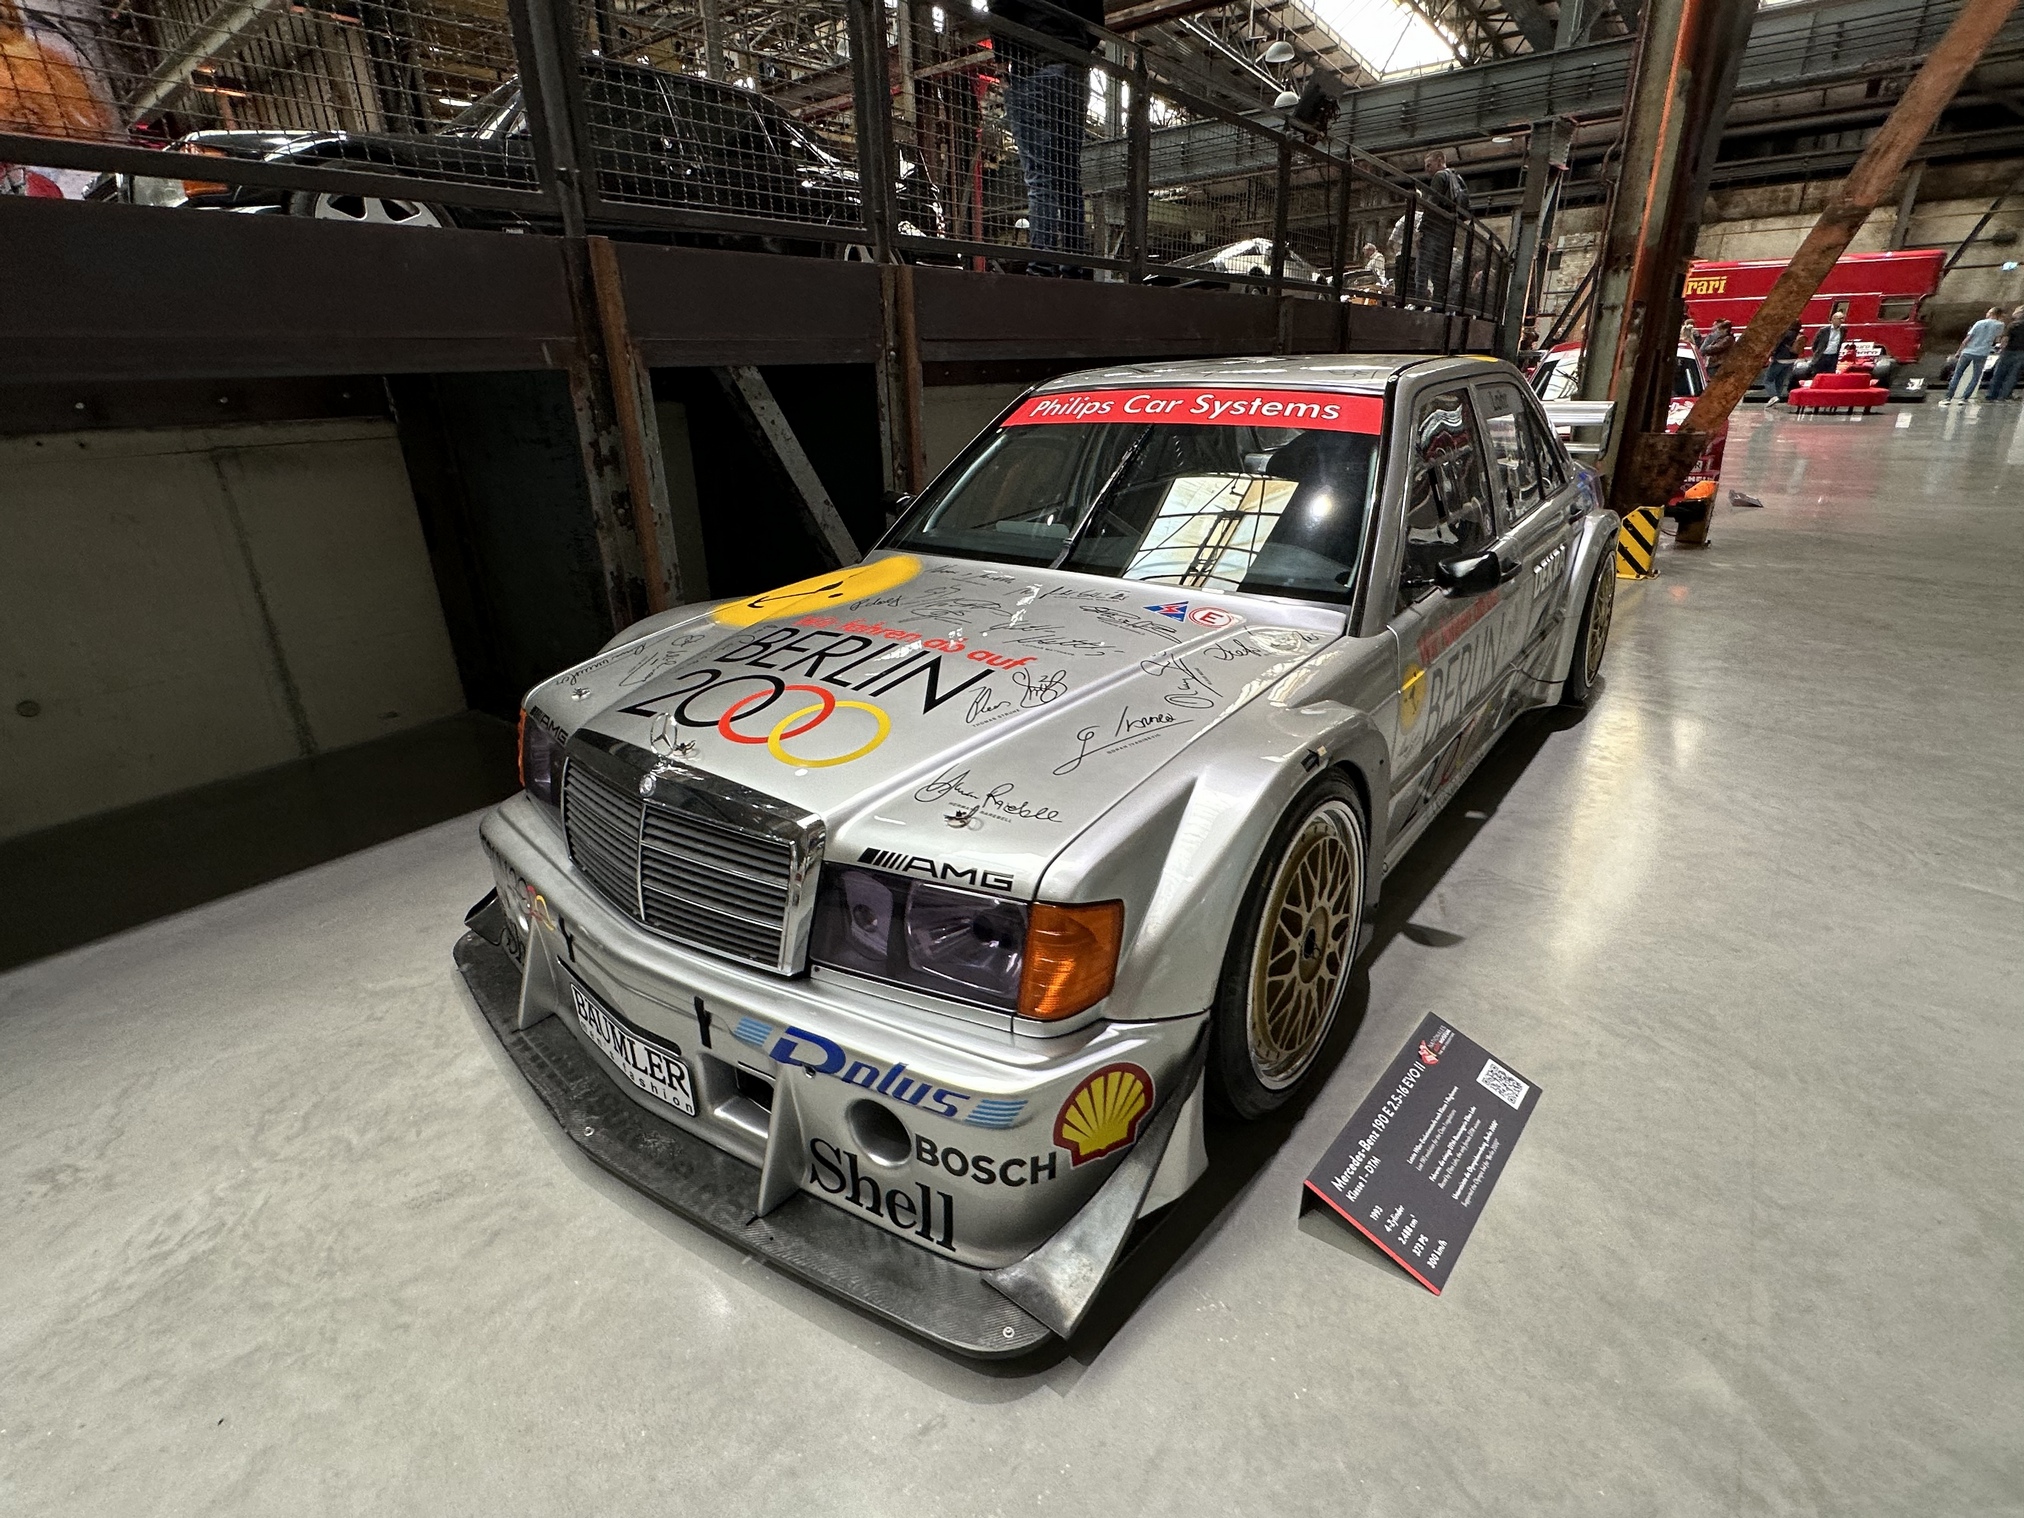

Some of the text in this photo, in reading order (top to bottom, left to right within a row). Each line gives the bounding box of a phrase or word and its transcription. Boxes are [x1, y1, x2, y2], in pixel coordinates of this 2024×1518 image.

[1686, 276, 1727, 295] rari
[1030, 393, 1341, 421] Philips Car Systems
[836, 617, 922, 642] fahren
[922, 636, 969, 653] ab
[966, 649, 1038, 671] auf
[716, 627, 995, 715] BERLIN
[540, 713, 569, 746] AMG
[617, 667, 893, 768] 2000
[902, 858, 1014, 892] AMG
[1331, 1061, 1426, 1192] Mercedes-Benz 190 E 2.5-16 EVO II
[915, 1133, 1058, 1187] BOSCH
[809, 1137, 957, 1253] Shell
[1345, 1182, 1365, 1202] Klasse
[1358, 1175, 1368, 1183] 1
[1364, 1155, 1381, 1174] DTM
[1369, 1205, 1383, 1221] 1993
[1384, 1205, 1405, 1232] 4-Zylinder
[1412, 1234, 1429, 1257] 373 PS
[1427, 1240, 1448, 1269] 300 km/h
